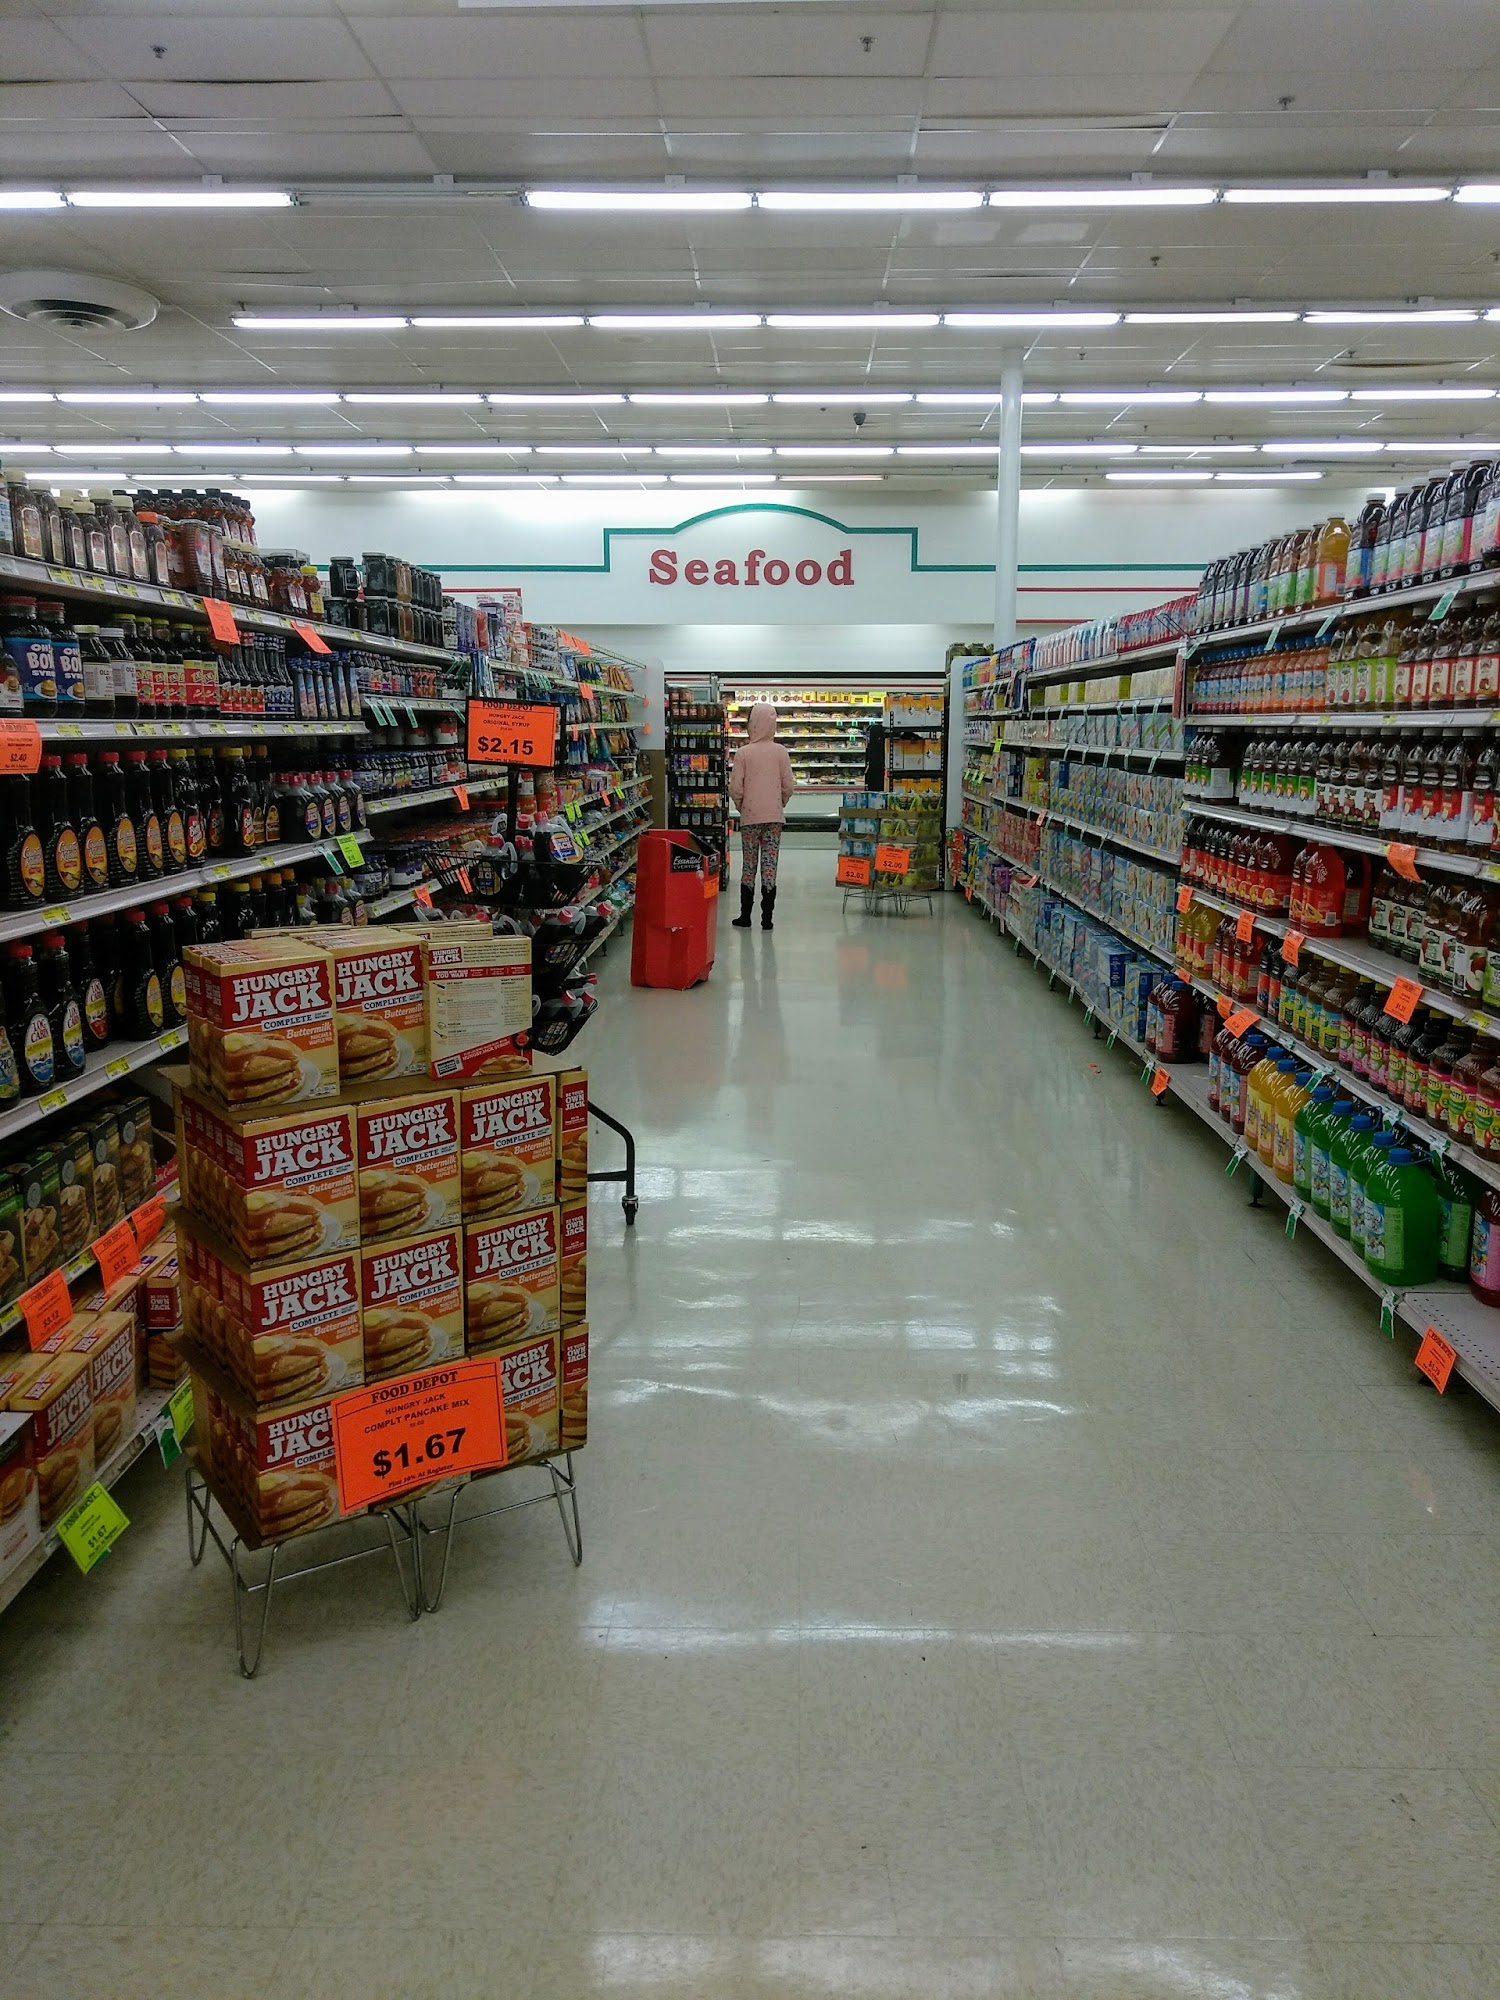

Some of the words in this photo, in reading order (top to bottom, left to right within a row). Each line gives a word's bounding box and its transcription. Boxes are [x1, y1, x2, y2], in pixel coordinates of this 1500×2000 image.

[648, 548, 855, 586] Seafood
[482, 700, 505, 710] FOOD
[507, 702, 534, 712] DEPOT
[477, 735, 533, 756] $2.15
[432, 948, 459, 957] HUNGRY
[432, 953, 461, 965] JACK
[336, 950, 413, 979] HUNGRY
[232, 965, 320, 995] HUNGRY
[336, 966, 419, 1003] JACK
[232, 983, 325, 1022] JACK
[364, 995, 407, 1010] COMPLETE
[263, 1014, 312, 1030] COMPLETE
[286, 1022, 332, 1039] Buttermilk
[472, 1087, 544, 1118] HUNGRY
[565, 1094, 584, 1104] OWN
[565, 1102, 585, 1111] JACK
[368, 1103, 447, 1134] HUNGRY
[470, 1102, 547, 1142] JACK
[255, 1120, 342, 1154] HUNGRY
[366, 1118, 451, 1160] JACK
[495, 1131, 535, 1147] COMPLETE
[514, 1137, 551, 1154] Buttermilk
[254, 1136, 347, 1181] JACK
[395, 1149, 439, 1165] COMPLETE
[415, 1155, 457, 1173] Buttermilk
[285, 1168, 334, 1186] COMPLETE
[308, 1175, 354, 1195] Buttermilk
[477, 1217, 548, 1249] HUNGRY
[565, 1228, 585, 1237] JACK
[566, 1220, 584, 1230] OWN
[372, 1239, 450, 1275] HUNGRY
[475, 1231, 551, 1274] JACK
[371, 1254, 454, 1300] JACK
[500, 1259, 541, 1278] COMPLETE
[518, 1265, 556, 1284] Buttermilk
[262, 1263, 347, 1301] HUNGRY
[150, 1298, 169, 1306] OWN
[261, 1278, 353, 1327] JACK
[399, 1285, 442, 1303] COMPLETE
[418, 1289, 459, 1310] Buttermilk
[292, 1310, 339, 1330] COMPLETE
[314, 1315, 358, 1336] Buttermilk
[93, 1327, 131, 1373] HUNGRY
[501, 1343, 549, 1374] NGRY
[567, 1346, 586, 1357] OWN
[567, 1354, 587, 1364] JACK
[94, 1343, 132, 1396] JACK
[501, 1357, 551, 1394] ACK
[47, 1370, 88, 1421] HUNGRY
[371, 1384, 409, 1404] FOOD
[413, 1370, 458, 1391] DEPOT
[503, 1386, 542, 1405] COMPLETE
[385, 1400, 420, 1415] HUNGRY
[423, 1393, 446, 1404] JACK
[47, 1384, 91, 1447] JACK
[267, 1405, 332, 1439] HUNG
[364, 1416, 402, 1435] COMPLT
[404, 1404, 449, 1421] PANCAKE
[451, 1398, 470, 1408] MIX
[267, 1421, 333, 1463] JAC
[297, 1447, 336, 1466] COMPLE
[373, 1427, 466, 1479] $1.67
[427, 1464, 454, 1475] Register
